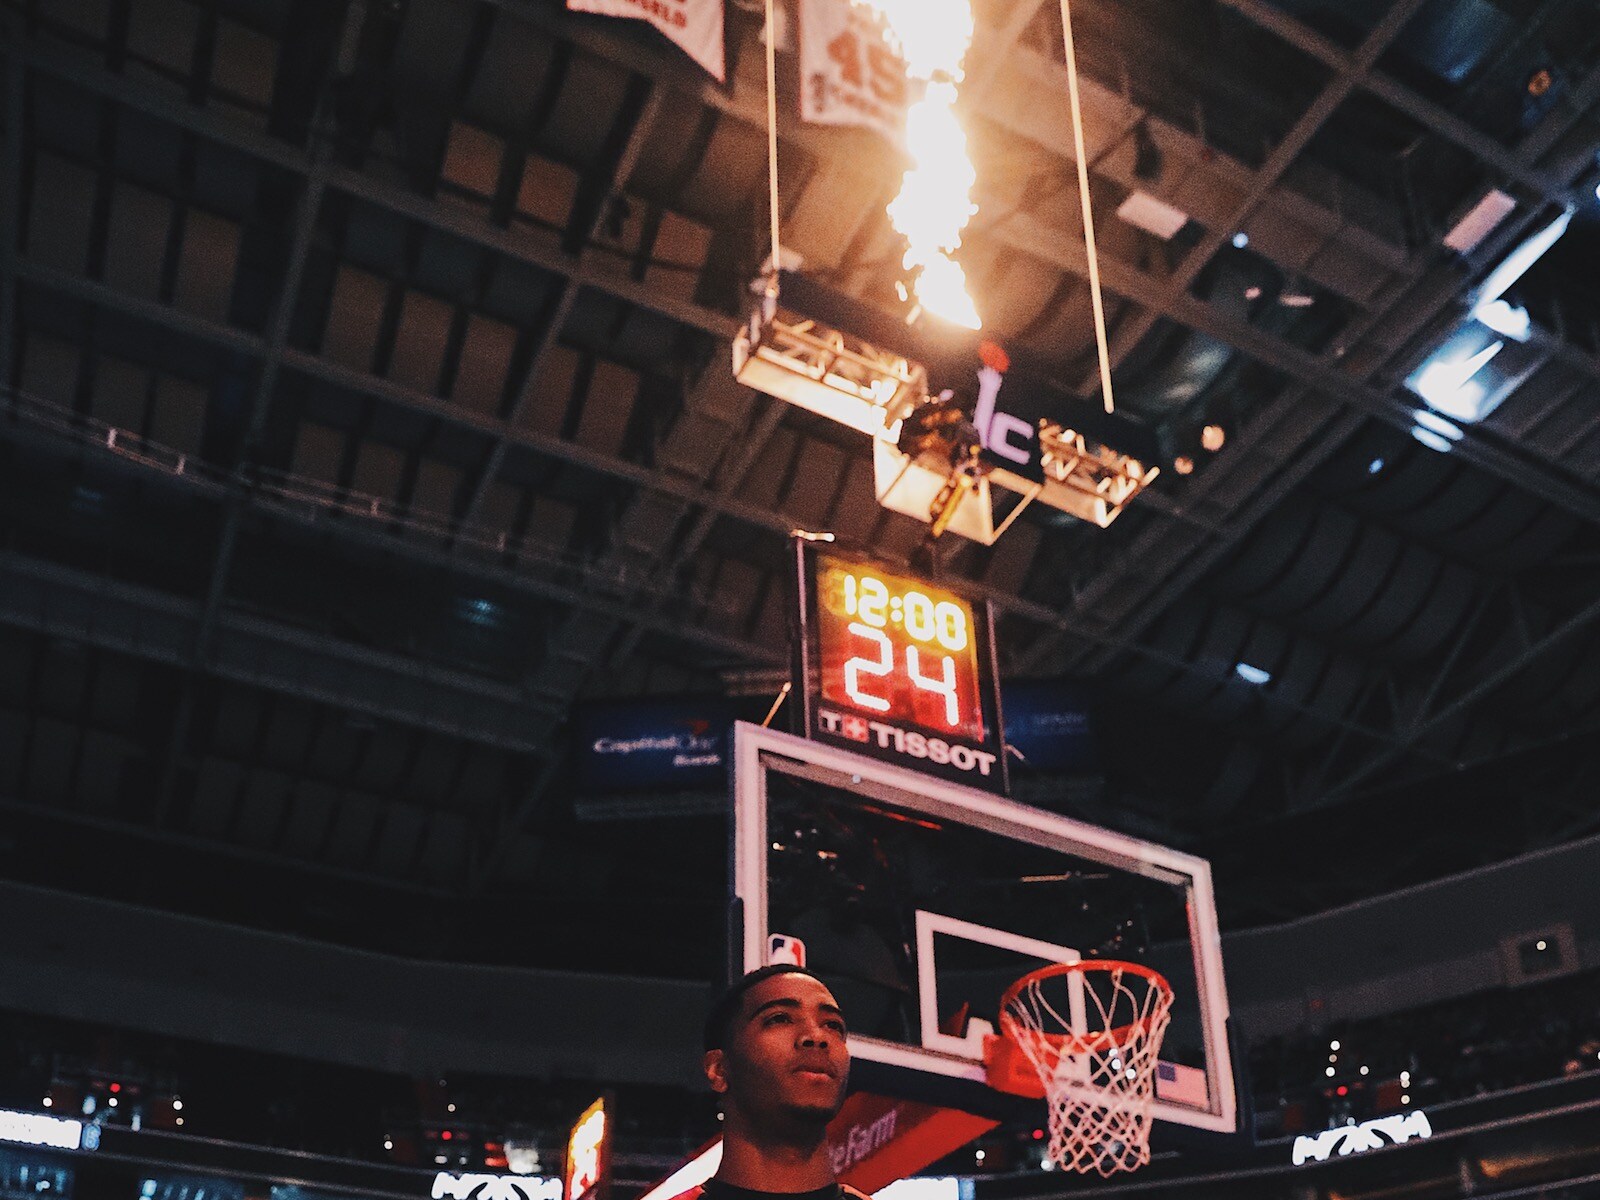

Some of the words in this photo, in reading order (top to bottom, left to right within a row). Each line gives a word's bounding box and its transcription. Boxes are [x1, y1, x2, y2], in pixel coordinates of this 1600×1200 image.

[844, 575, 968, 651] 12:00
[844, 623, 959, 727] 24
[869, 720, 997, 777] TISSOT
[829, 1109, 897, 1174] eFarm
